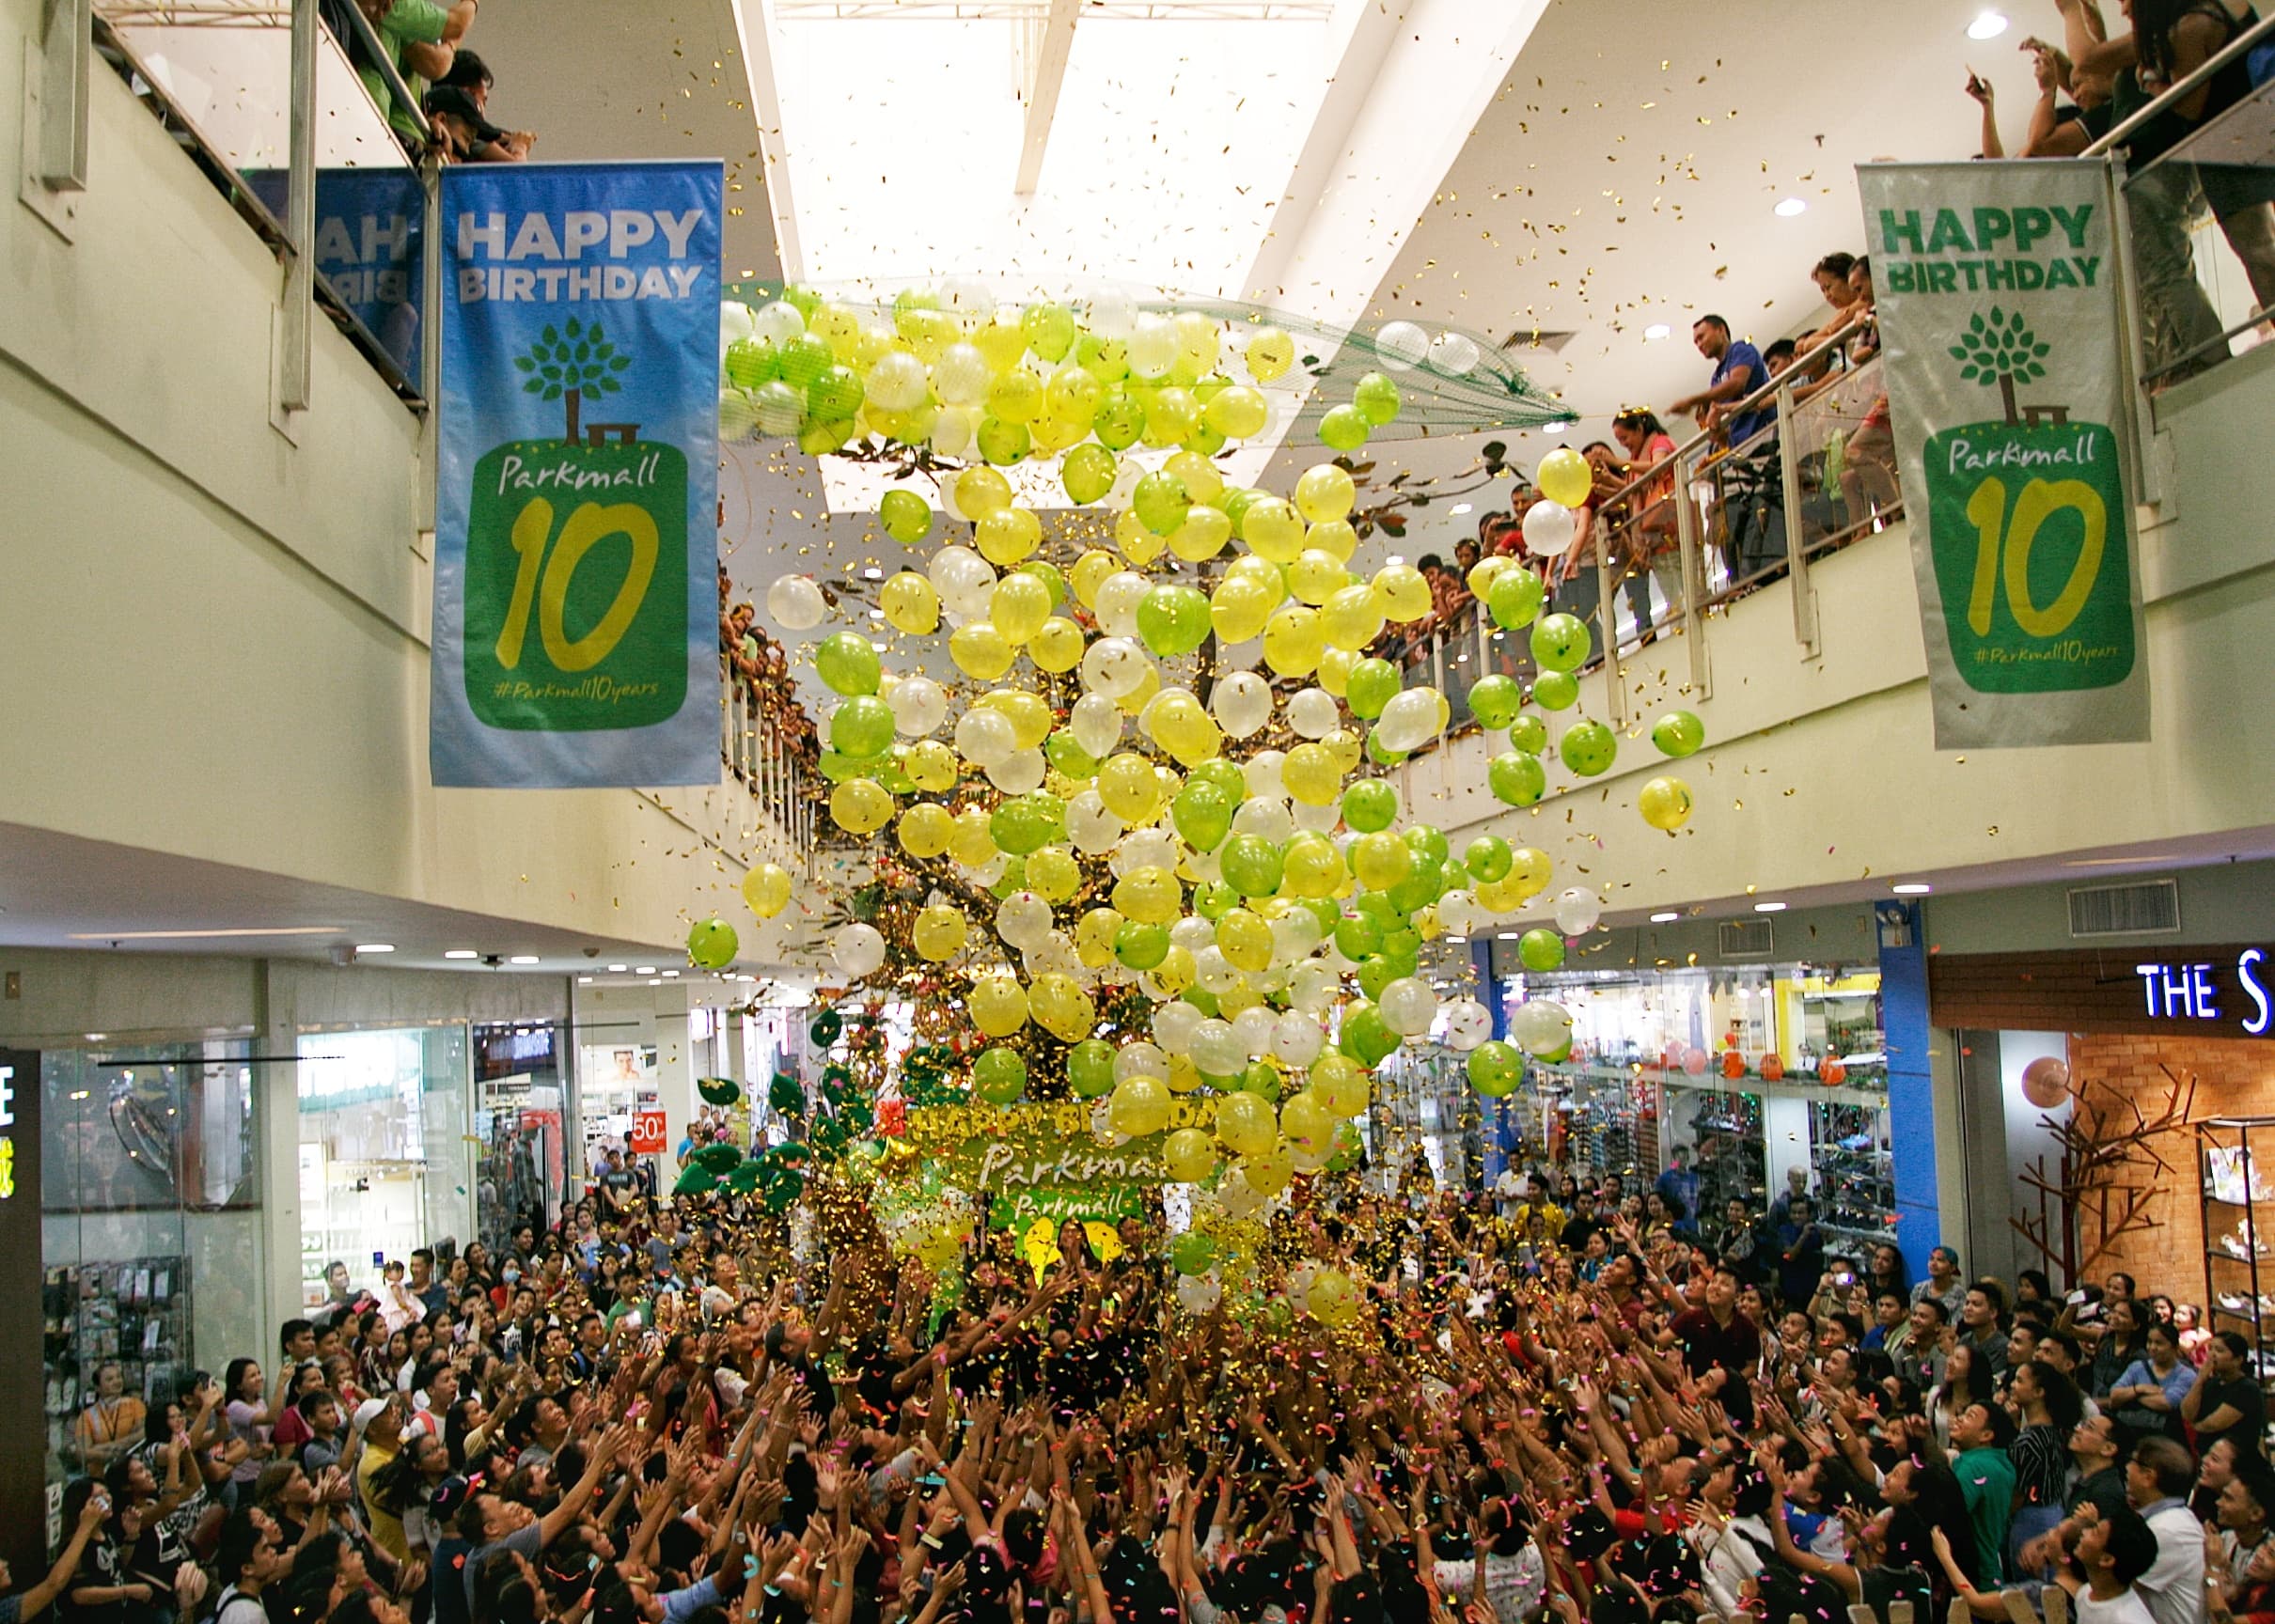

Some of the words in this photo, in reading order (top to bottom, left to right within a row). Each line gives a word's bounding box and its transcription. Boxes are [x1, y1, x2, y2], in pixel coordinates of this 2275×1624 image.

[458, 210, 703, 260] HAPPY
[1878, 204, 2095, 254] HAPPY
[459, 265, 703, 304] BIRTHDAY
[1887, 257, 2100, 293] BIRTHDAY
[498, 451, 660, 496] Parkmall
[1949, 431, 2095, 475] Parkmall
[1966, 476, 2107, 637] 10
[495, 496, 659, 672] 10
[1976, 640, 2119, 666] #Parkmall10years
[494, 675, 658, 704] #Parkmall10years
[2136, 963, 2218, 1019] THE
[979, 1143, 1166, 1191] Parkma
[1014, 1188, 1123, 1221] Parkmall
